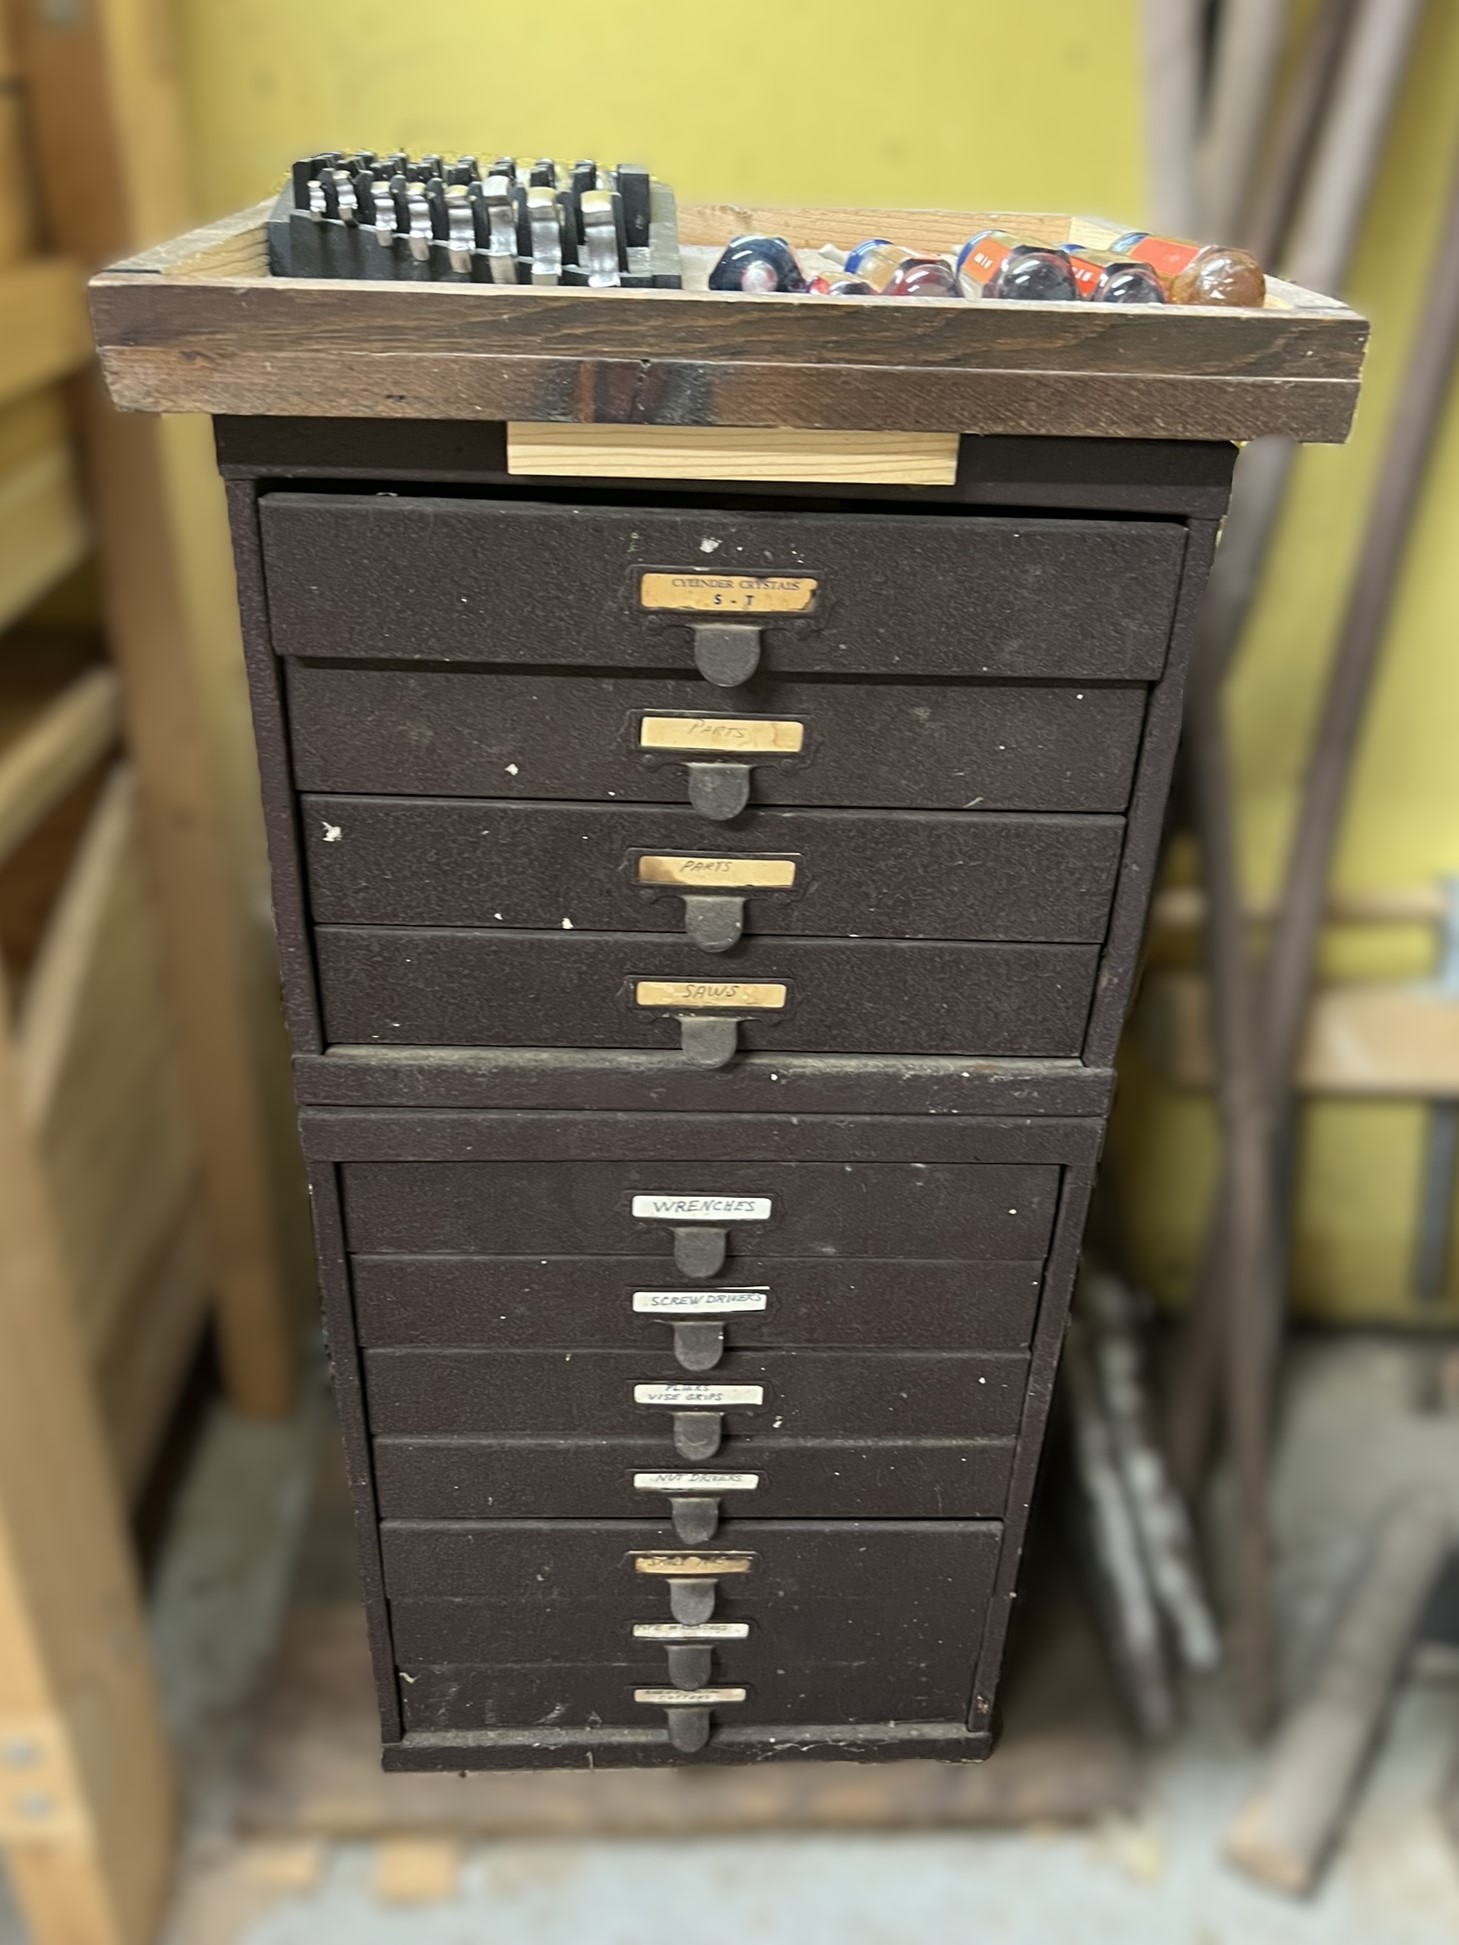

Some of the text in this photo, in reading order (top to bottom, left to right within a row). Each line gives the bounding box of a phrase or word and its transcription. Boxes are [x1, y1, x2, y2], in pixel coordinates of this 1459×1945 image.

[671, 578, 802, 592] CYLINDER CRYSTALS
[713, 593, 723, 606] S
[745, 594, 755, 606] T
[687, 719, 747, 739] PARTS
[680, 860, 733, 873] PARTS
[682, 984, 741, 999] SAWS
[652, 1199, 757, 1214] WRENCHES
[648, 1393, 724, 1402] VISE GRIPS
